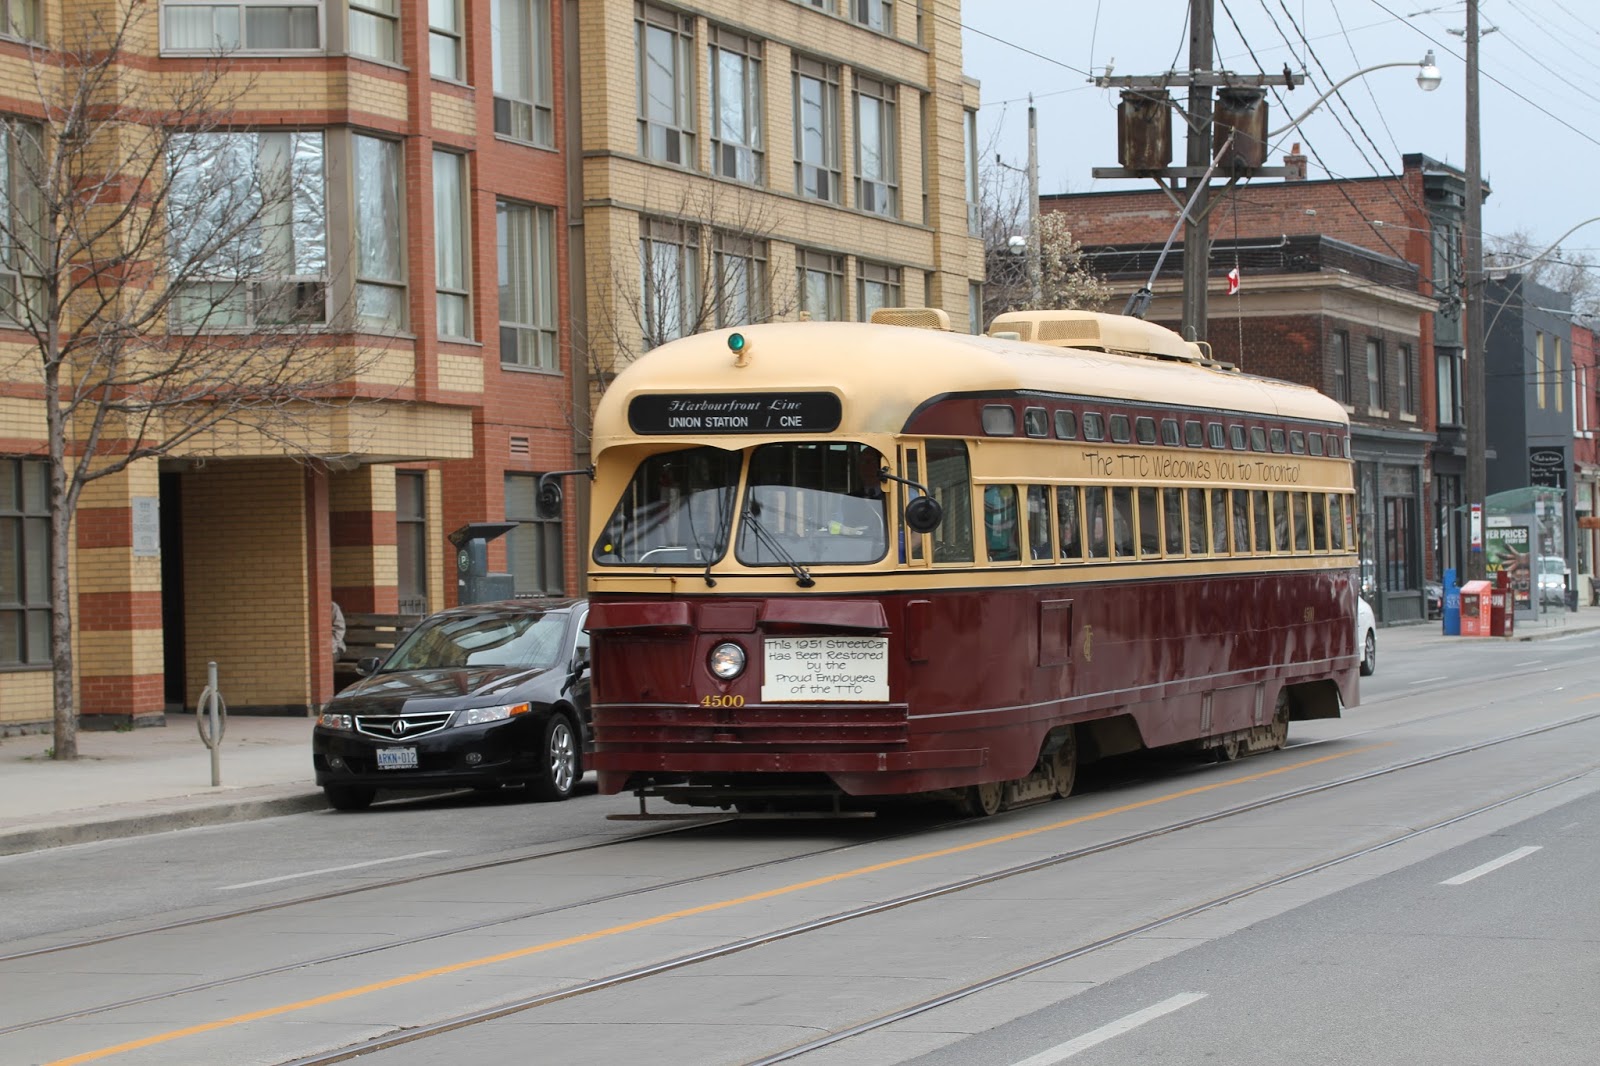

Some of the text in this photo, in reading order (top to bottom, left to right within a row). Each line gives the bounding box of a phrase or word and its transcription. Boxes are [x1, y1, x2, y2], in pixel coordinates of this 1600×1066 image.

[669, 399, 802, 412] Harbourfront Line
[668, 417, 701, 428] UNION
[705, 416, 748, 427] STATION
[780, 415, 802, 426] CNE
[1117, 454, 1149, 477] TTC
[1153, 455, 1211, 480] Welcomes
[1215, 459, 1235, 480] You
[1238, 461, 1252, 481] to
[1500, 529, 1527, 538] PRICES
[461, 555, 466, 564] P
[766, 639, 887, 650] This 1951 StreetCar
[768, 651, 884, 661] Has Been Restored
[806, 660, 846, 672] by the
[776, 673, 876, 684] Proud Employees
[790, 685, 863, 695] of the TTC
[701, 695, 744, 708] 4500
